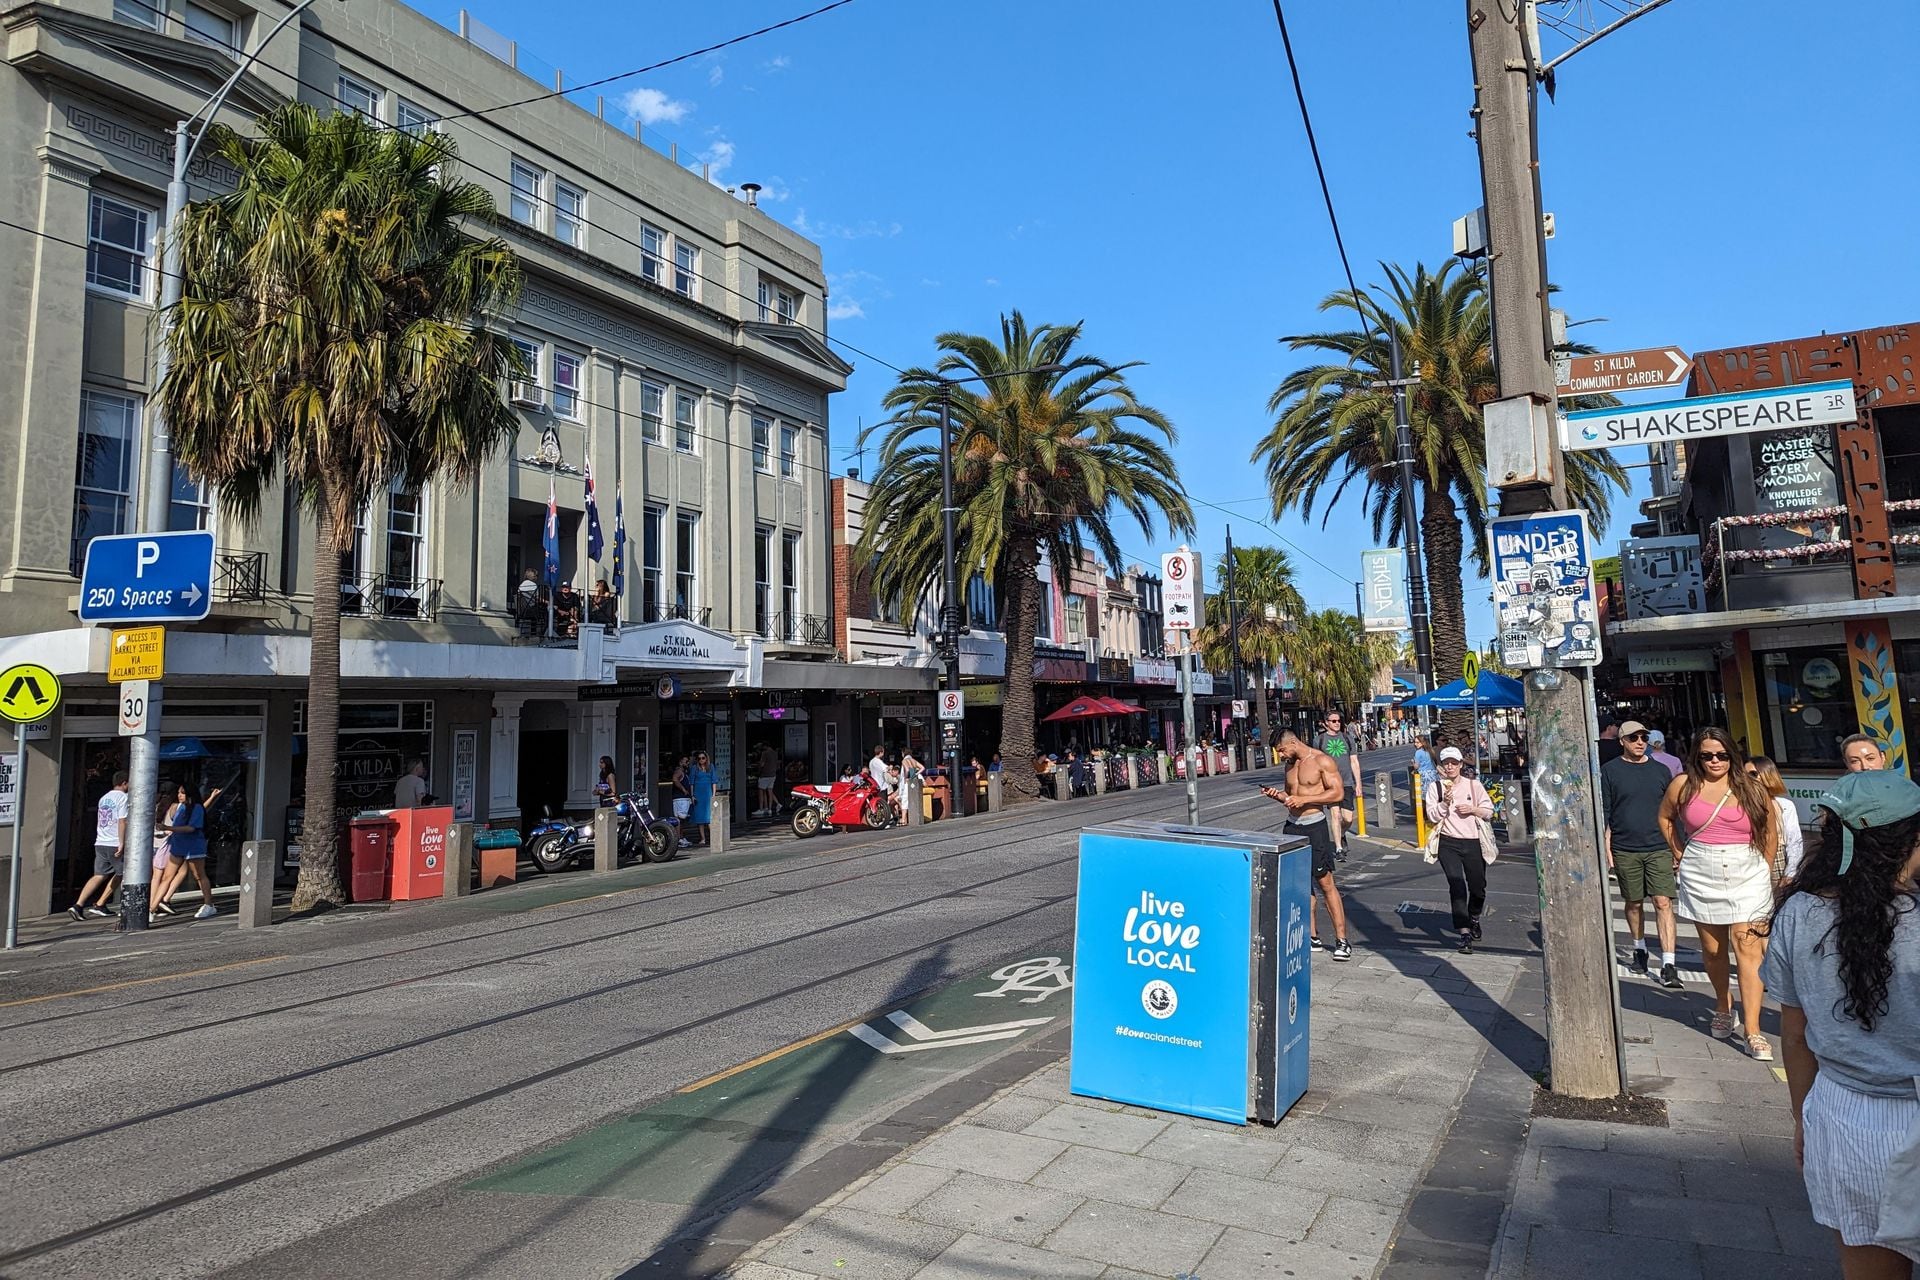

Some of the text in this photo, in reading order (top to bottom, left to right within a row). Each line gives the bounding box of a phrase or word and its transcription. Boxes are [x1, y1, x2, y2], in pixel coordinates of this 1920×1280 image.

[1594, 356, 1636, 372] ST KILDA
[1570, 370, 1664, 390] COMMUNITY GARDEN
[1606, 398, 1813, 442] SHAKESPEARE
[1761, 438, 1813, 453] MASTER
[1762, 449, 1815, 463] CLASSES
[1770, 462, 1810, 476] EVERY
[1763, 472, 1821, 487] MONDAY
[1769, 488, 1823, 500] KNOWLEDGE
[1776, 497, 1818, 508] IS POWER
[1497, 529, 1579, 556] UNDER
[136, 541, 160, 578] P
[1165, 593, 1192, 601] FOOTPATH
[1556, 585, 1582, 596] O$B
[87, 587, 173, 610] 250 Spaces
[128, 632, 158, 642] ACCESS TO
[1505, 634, 1527, 642] SHEN
[115, 643, 159, 655] BARKLY STREET
[648, 645, 710, 658] MEMORIAL HALL
[131, 656, 141, 664] VIA
[113, 665, 158, 676] ACLAND STREET
[124, 698, 143, 718] 30
[885, 706, 900, 715] FISH
[908, 706, 928, 715] CHIPS
[353, 758, 393, 776] KILDA
[425, 826, 439, 834] live
[421, 844, 442, 853] LOCAL
[1141, 890, 1185, 918] live
[1290, 902, 1301, 924] live
[1127, 947, 1196, 973] LOCAL
[1286, 954, 1302, 979] LOCAL
